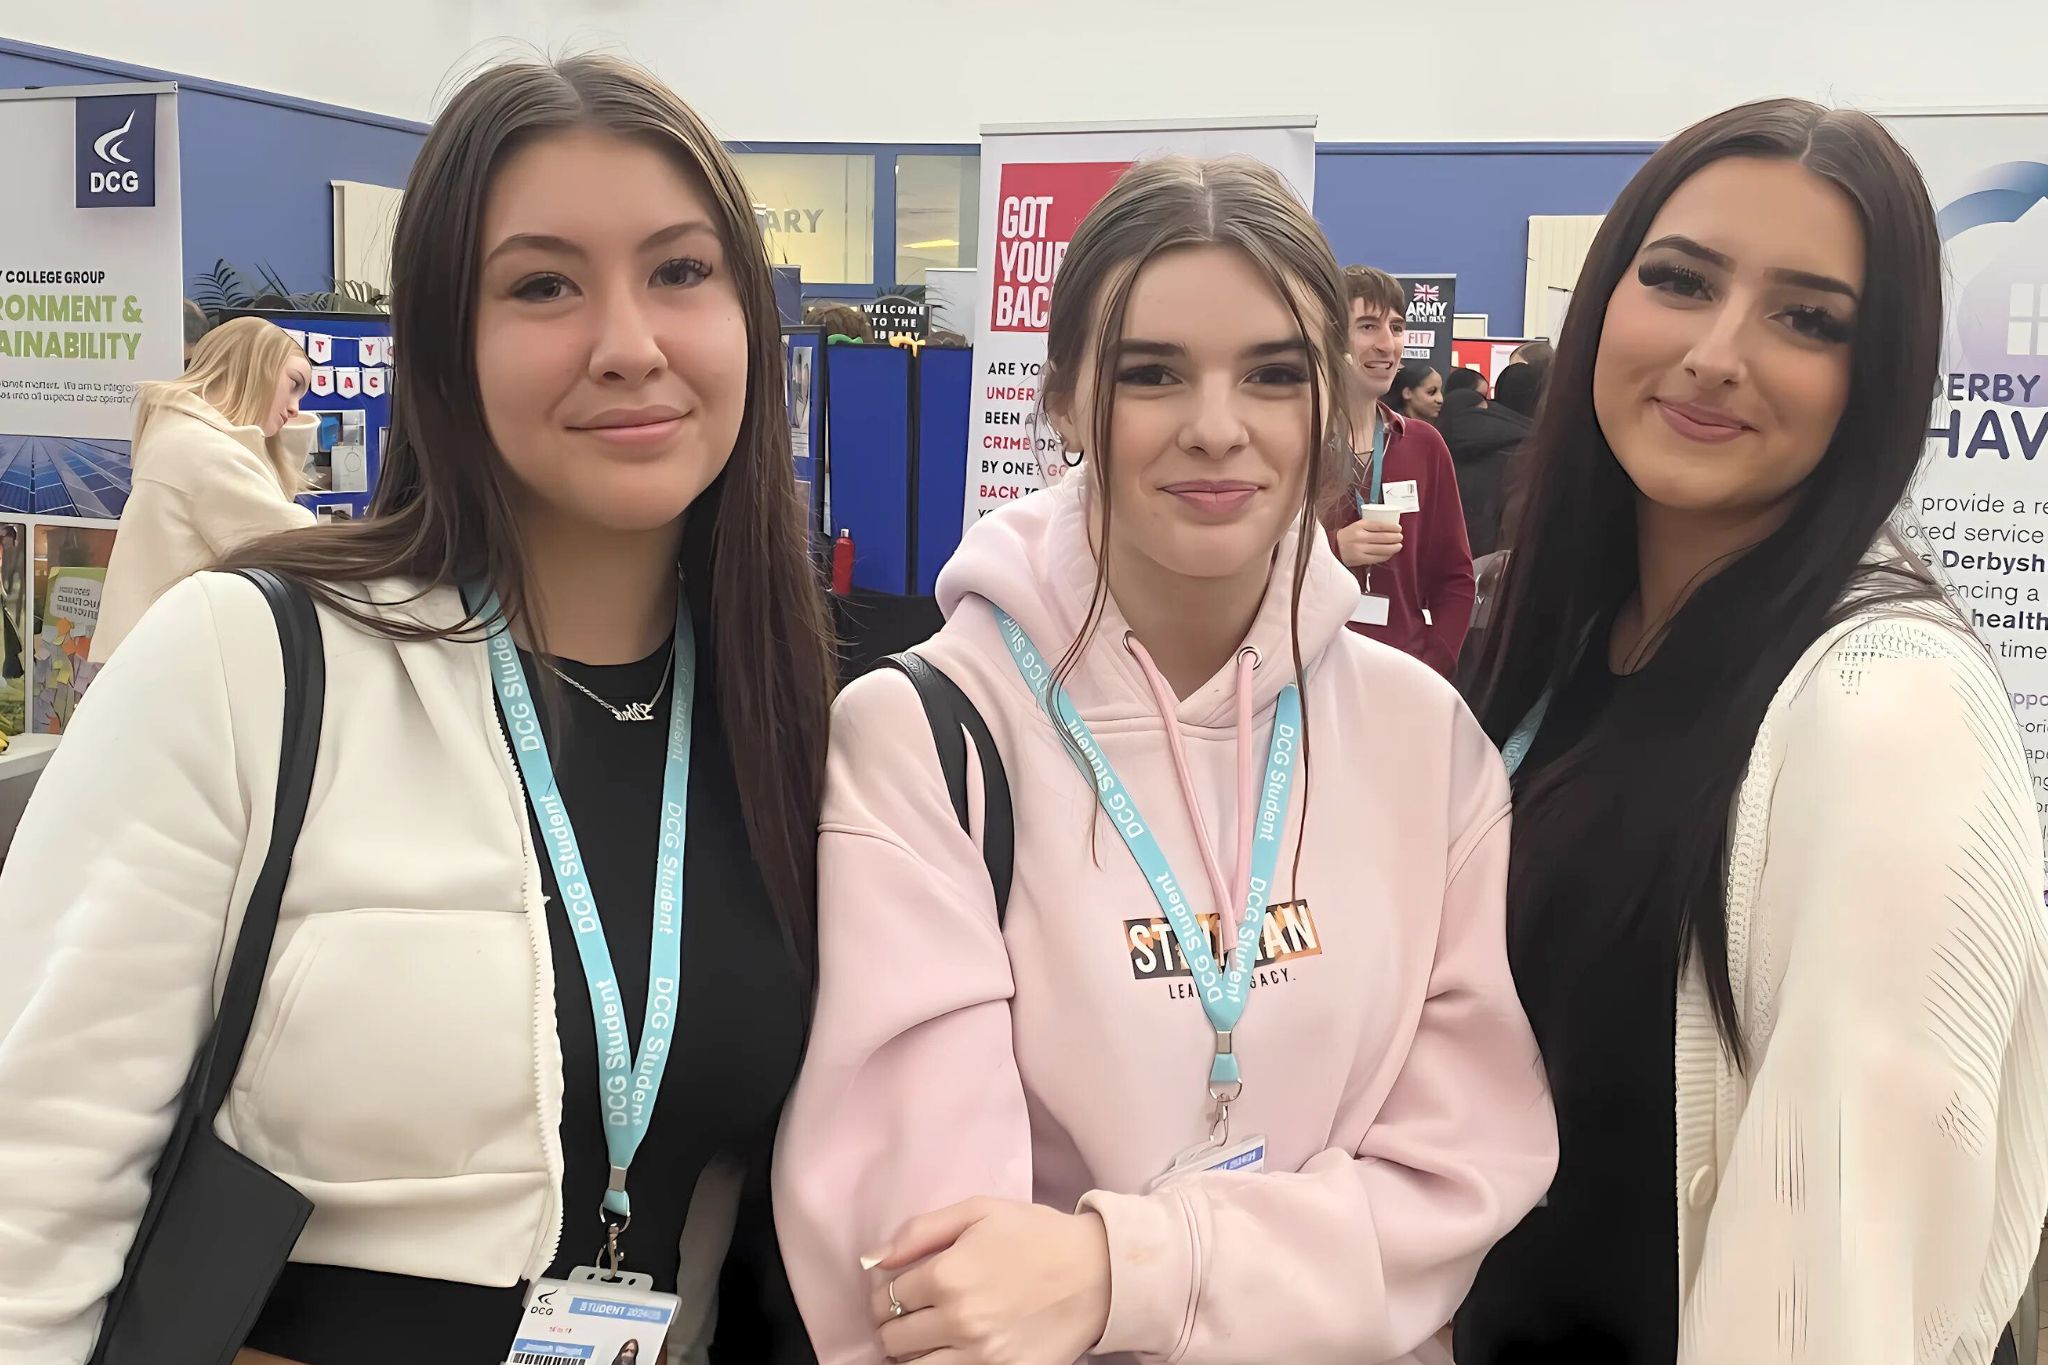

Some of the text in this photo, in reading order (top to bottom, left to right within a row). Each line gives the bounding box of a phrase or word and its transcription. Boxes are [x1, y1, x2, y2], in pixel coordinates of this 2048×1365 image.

[90, 171, 138, 193] DCG
[764, 209, 824, 233] ARY
[1002, 196, 1053, 239] GOT
[5, 271, 62, 284] COLLEGE
[64, 271, 105, 284] GROUP
[0, 294, 143, 323] ONMENT &
[863, 304, 925, 315] WELCOME
[996, 285, 1051, 328] BAC
[1406, 302, 1448, 316] ARMY
[872, 317, 917, 328] TO THE
[988, 363, 1041, 376] ARE YO
[987, 387, 1036, 401] UNDER
[1948, 373, 2040, 402] ERBY
[985, 412, 1021, 424] BEEN
[983, 436, 1057, 451] CRIME OR
[1927, 409, 2048, 461] HAV
[981, 461, 1068, 477] BY ONE? GO
[980, 485, 1019, 499] BACK
[1922, 493, 2004, 515] provide
[2013, 500, 2026, 514] a
[2034, 500, 2048, 515] re
[1964, 524, 2044, 543] service
[1942, 550, 2046, 575] Derbysh
[2027, 588, 2040, 602] a
[1971, 609, 2048, 630] health
[2001, 640, 2047, 660] time
[493, 636, 541, 752] DCG Stude
[1259, 724, 1294, 842] DCG Student
[1109, 794, 1145, 840] DCG
[540, 794, 596, 934] DCG Student
[659, 802, 682, 936] DCG Student
[1156, 871, 1223, 1004] DCG Student
[1226, 876, 1267, 1003] DCG Student
[595, 978, 628, 1127] DCG Student
[632, 977, 673, 1127] DCG Student
